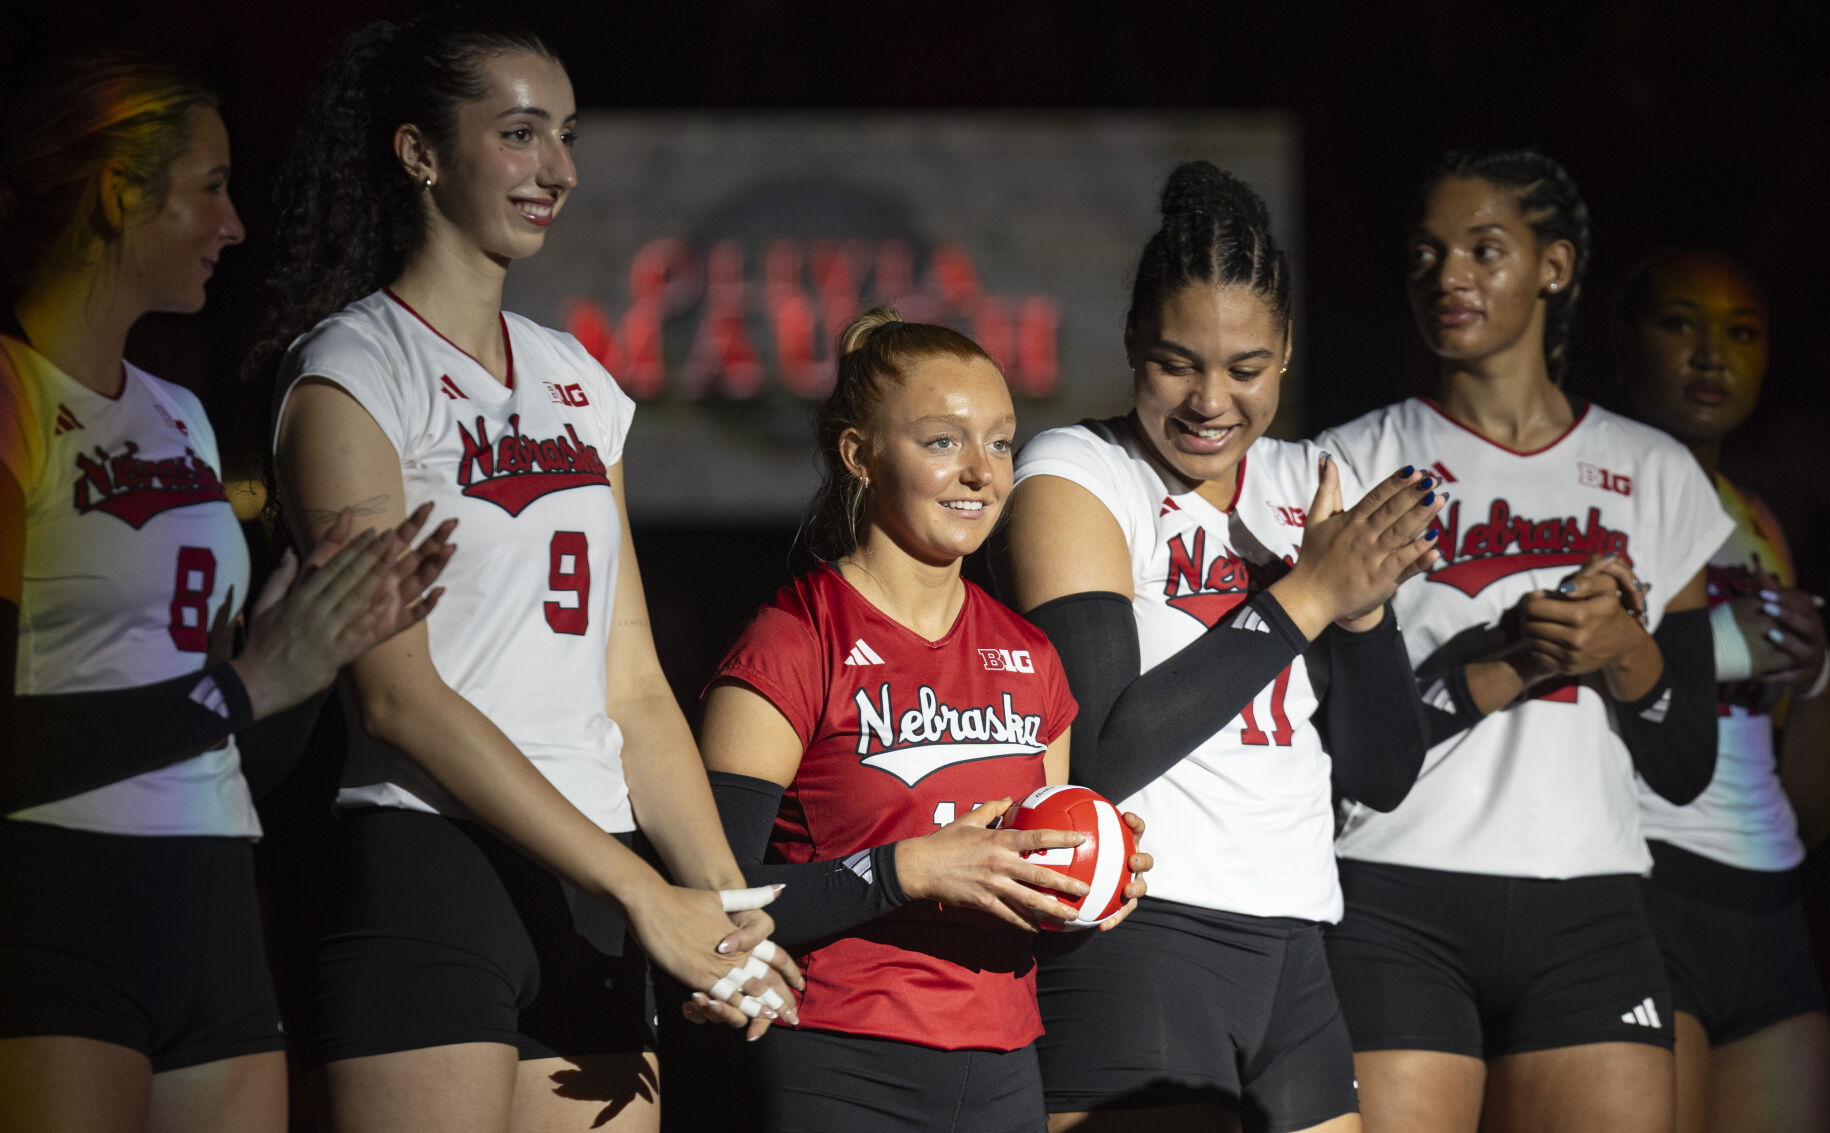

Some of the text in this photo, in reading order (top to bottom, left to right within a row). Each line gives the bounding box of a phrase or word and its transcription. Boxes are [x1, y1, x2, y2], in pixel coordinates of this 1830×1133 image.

[457, 413, 607, 486] Nebraska
[168, 545, 217, 653] 8
[543, 530, 590, 636] 9
[855, 683, 1044, 755] Nebraska
